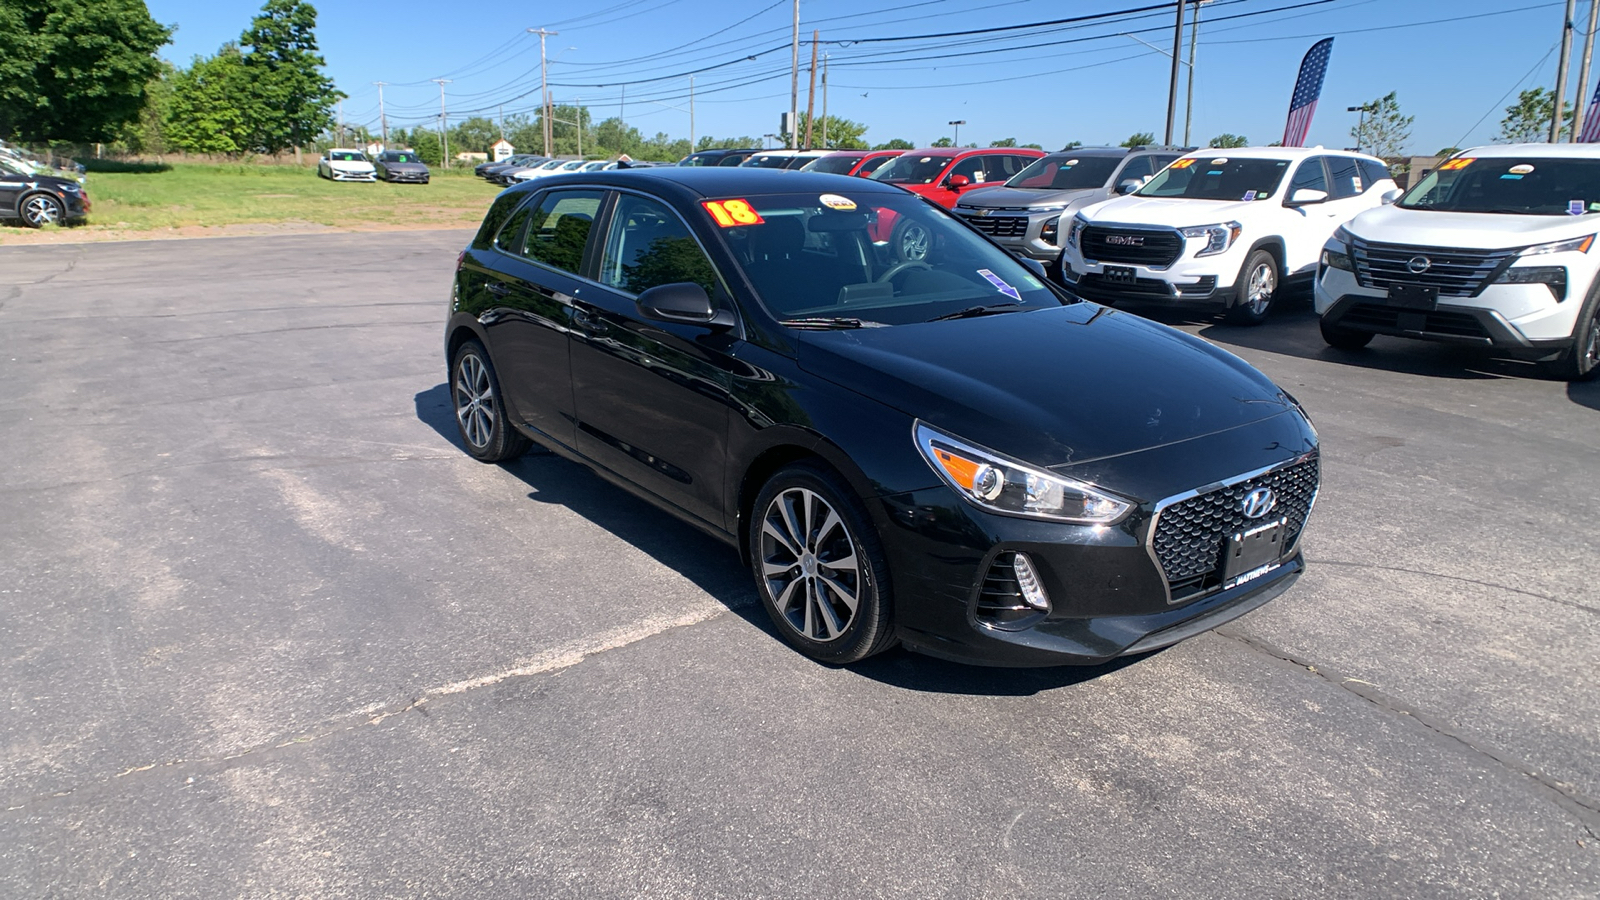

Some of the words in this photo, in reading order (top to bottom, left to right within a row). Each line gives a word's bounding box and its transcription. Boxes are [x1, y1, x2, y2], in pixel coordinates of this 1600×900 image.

[1170, 159, 1195, 168] 24
[1439, 158, 1475, 170] 24
[707, 200, 757, 225] 18
[1105, 235, 1144, 247] GMC
